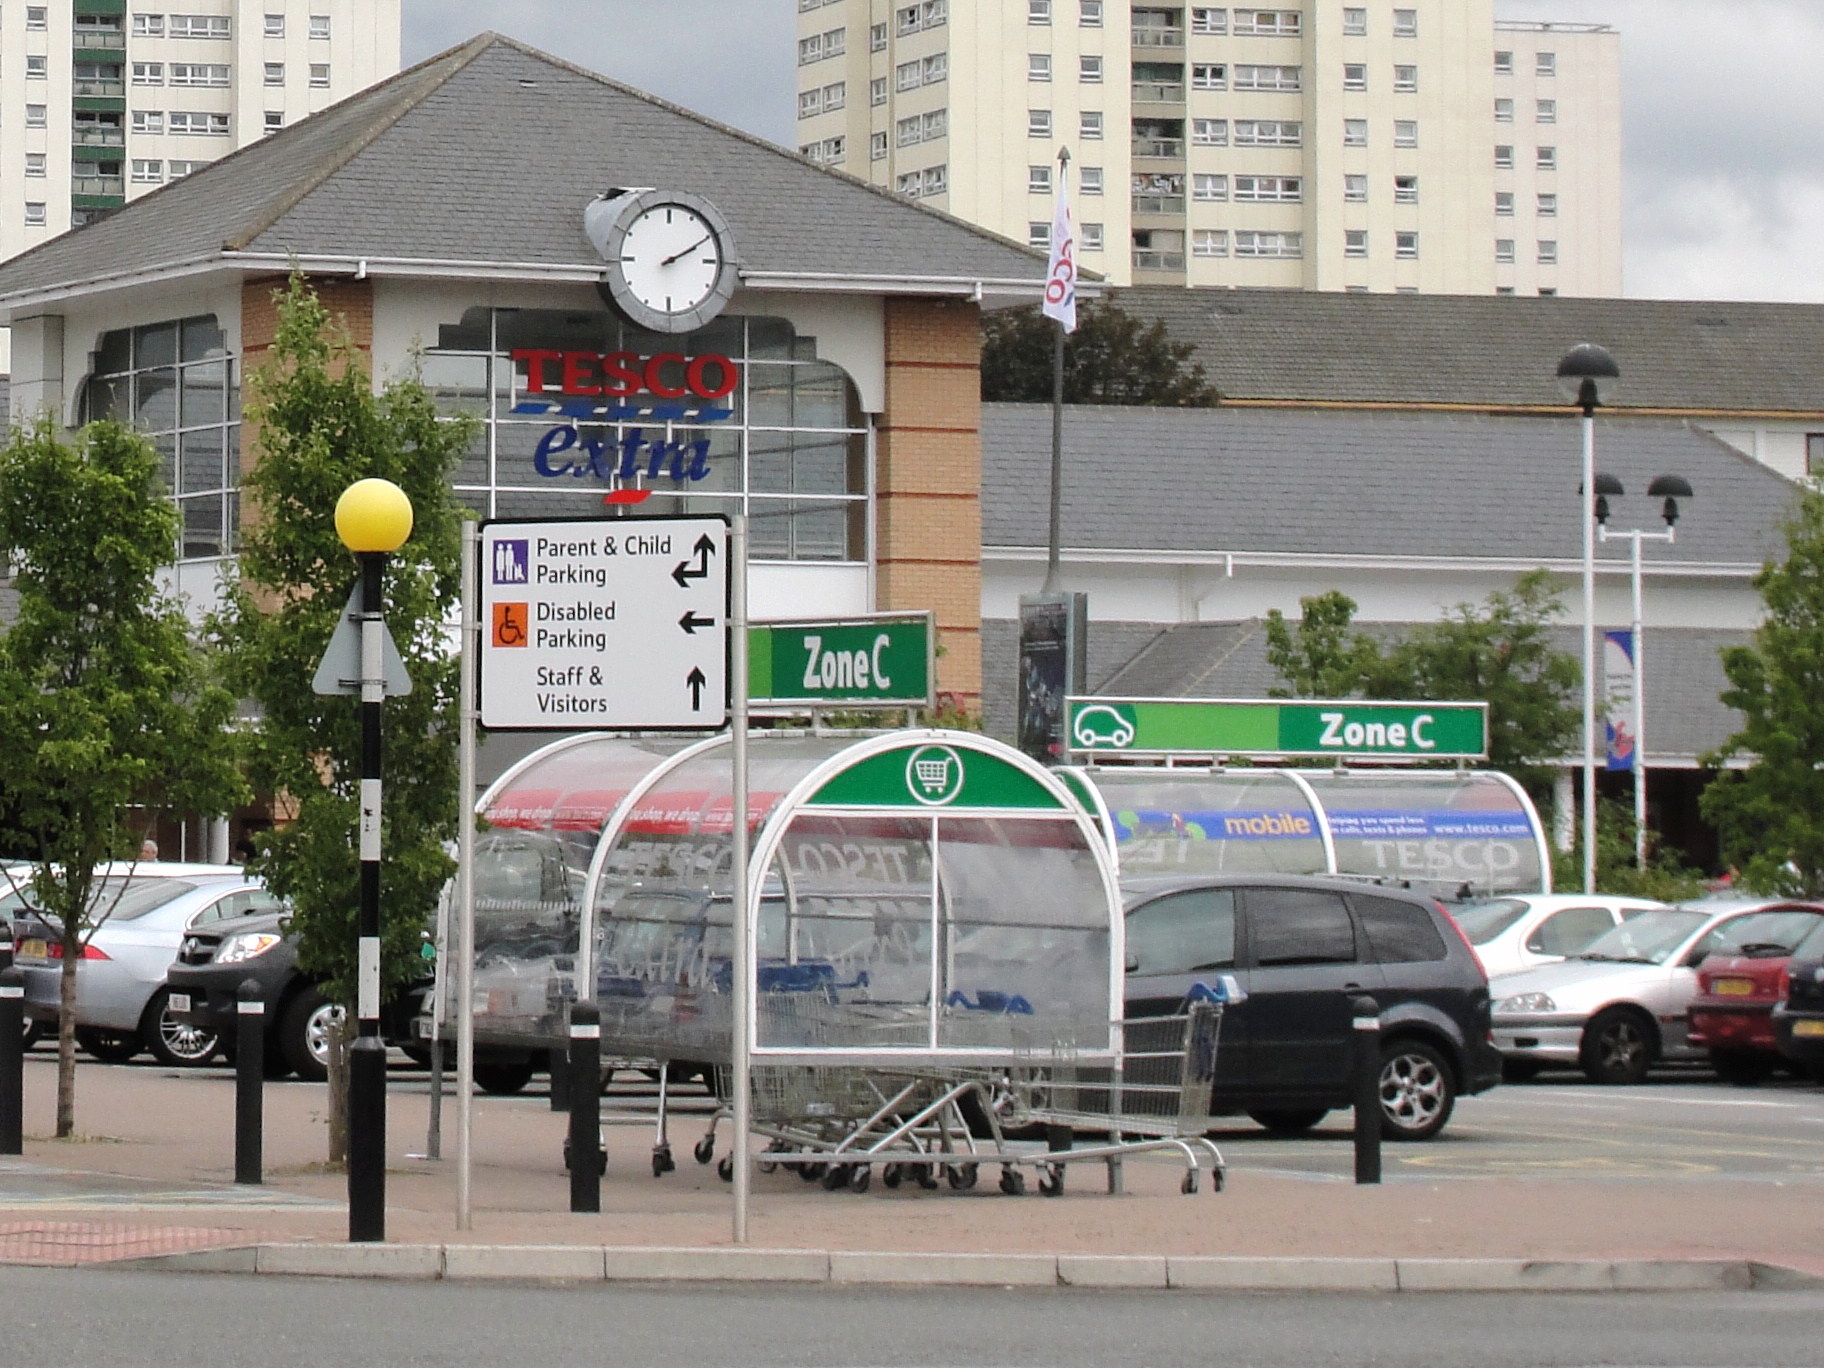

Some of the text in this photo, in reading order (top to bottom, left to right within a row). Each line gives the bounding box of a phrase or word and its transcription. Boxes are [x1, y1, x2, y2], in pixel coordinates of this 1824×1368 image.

[511, 348, 738, 399] TESCO
[534, 424, 711, 481] extra
[537, 534, 672, 557] Parent & Child
[537, 564, 607, 587] Parking
[537, 601, 616, 621] Disabled
[537, 628, 607, 652] Parking
[803, 634, 891, 690] Zone C
[537, 665, 603, 686] Staff &
[537, 692, 607, 713] Visitors
[1319, 712, 1436, 750] Zone C
[1224, 813, 1311, 835] mobile
[1433, 823, 1529, 833] www.tesco.com
[1361, 838, 1519, 870] TESCO
